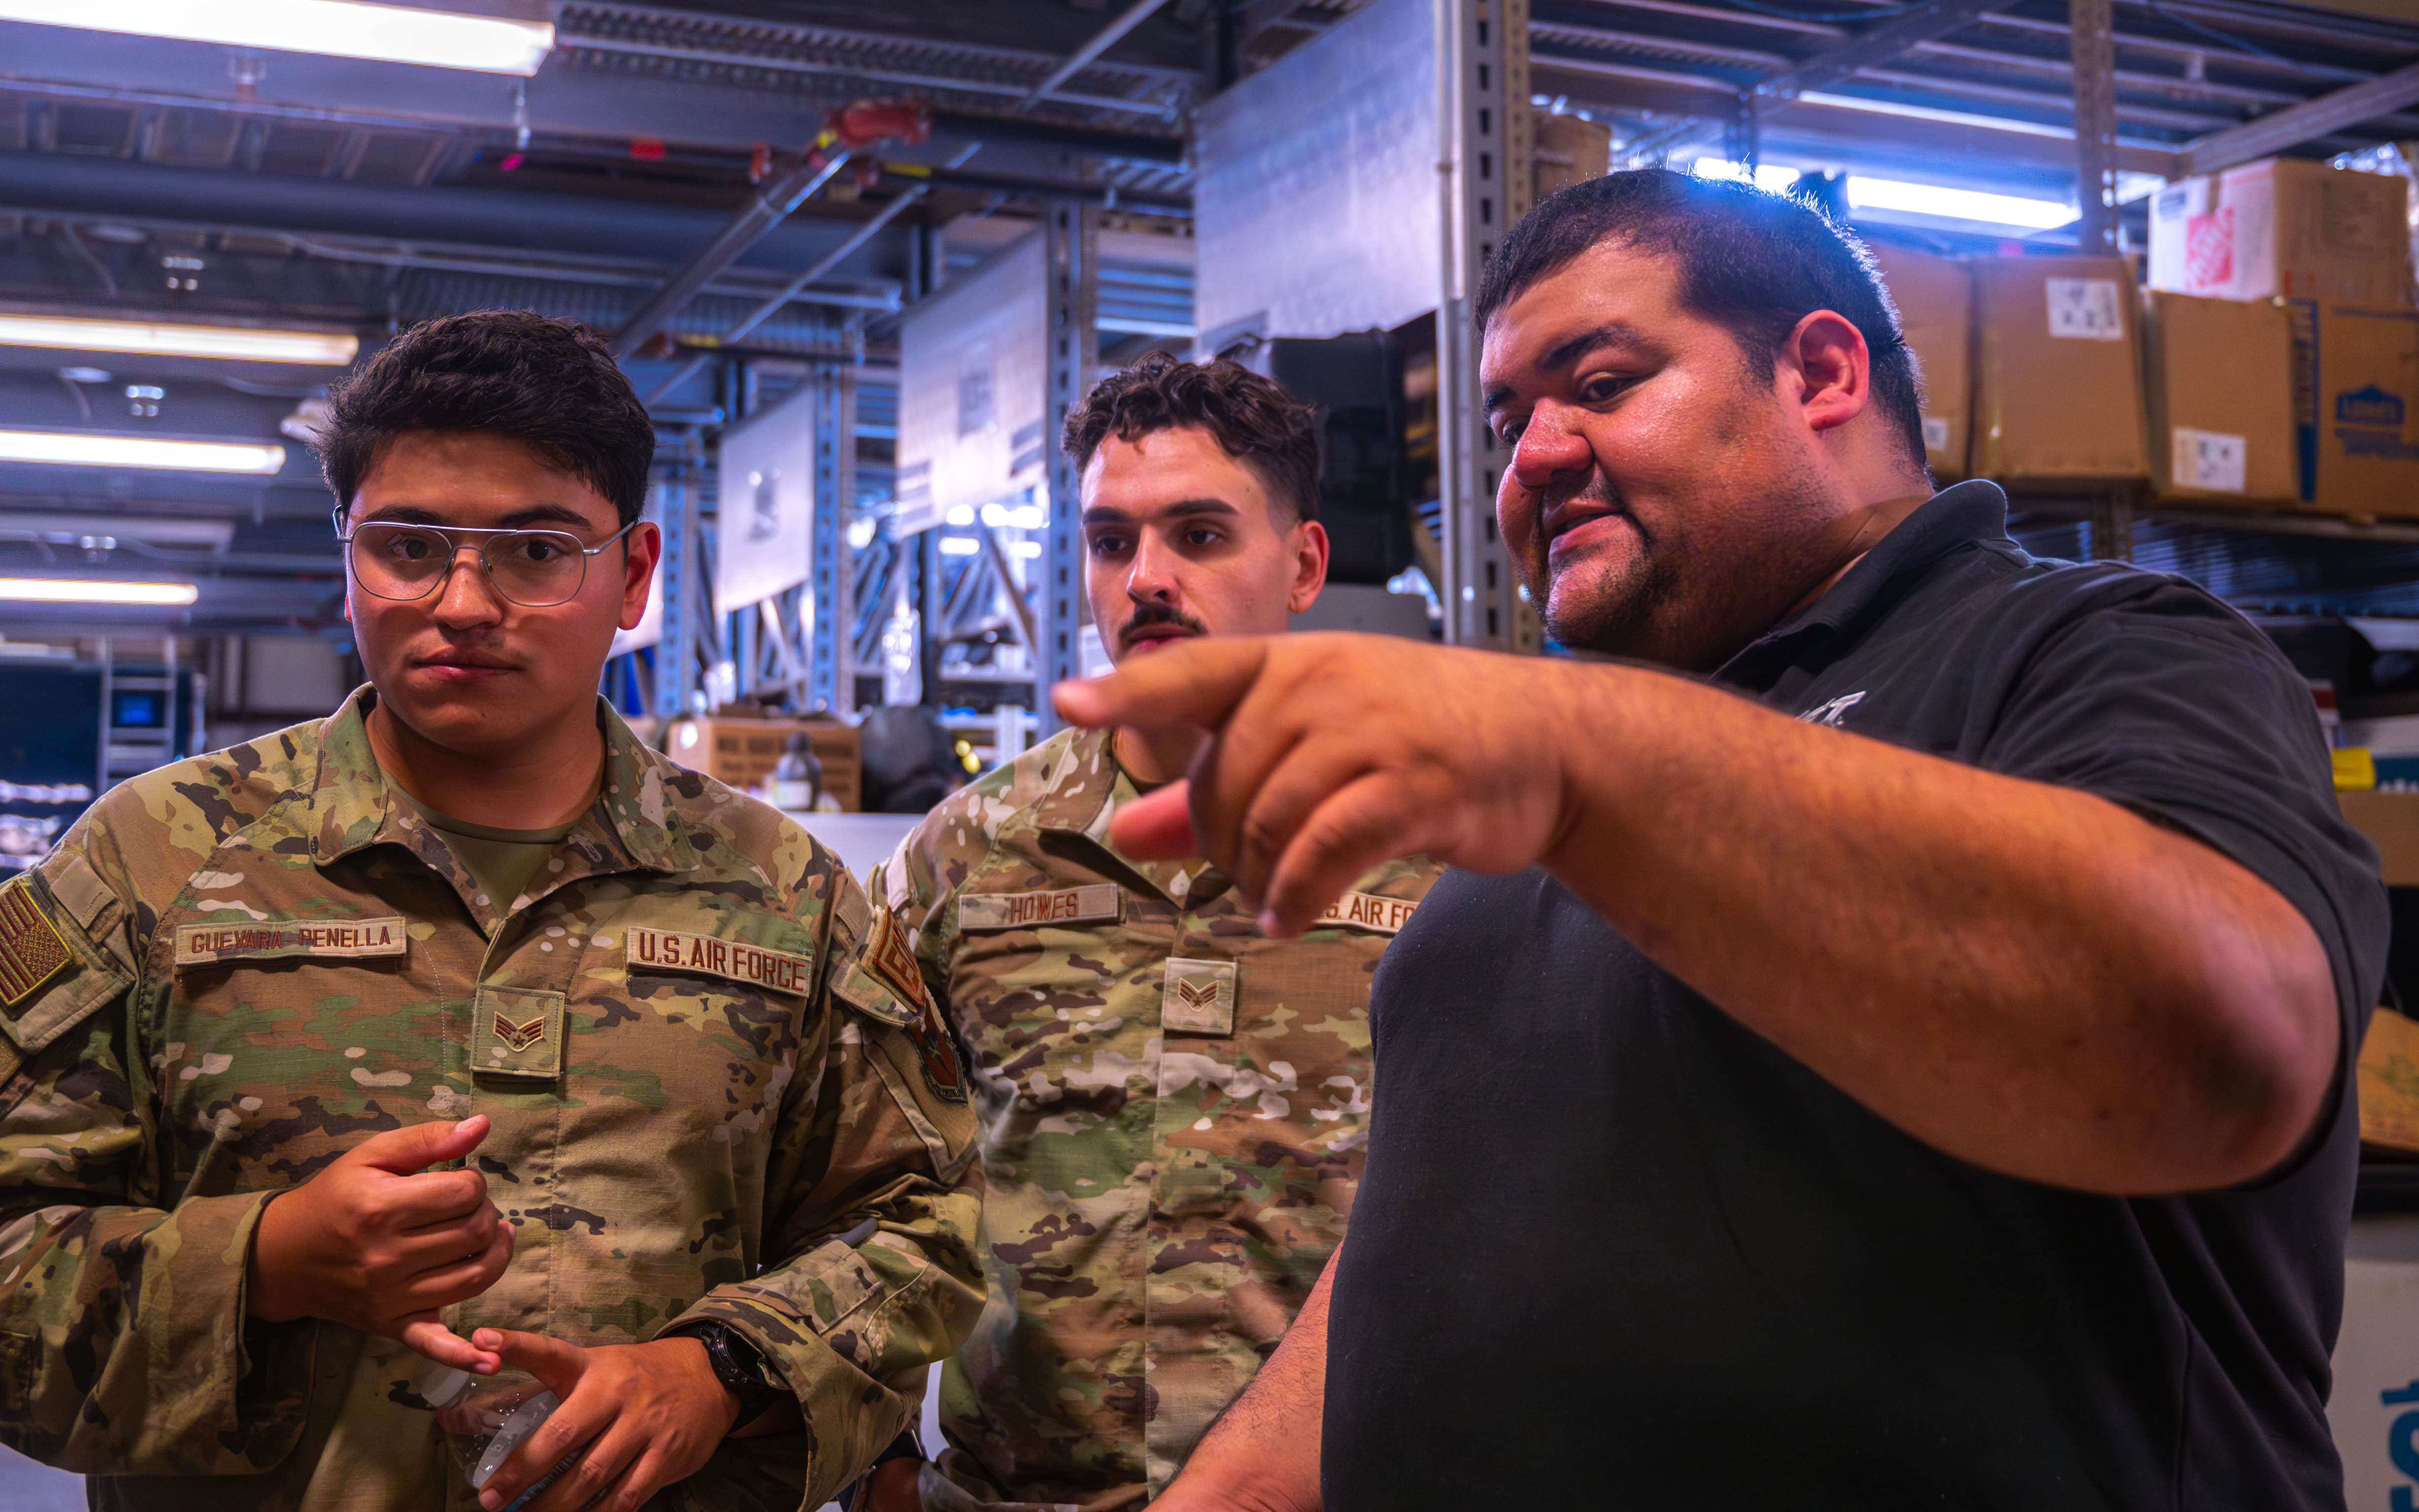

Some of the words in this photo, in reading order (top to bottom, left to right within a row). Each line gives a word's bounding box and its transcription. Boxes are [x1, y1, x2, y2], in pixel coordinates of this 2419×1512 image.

[1011, 893, 1079, 923] HOWES
[1349, 895, 1383, 926] AIR
[690, 938, 726, 974] AIR
[733, 946, 806, 992] FORCE
